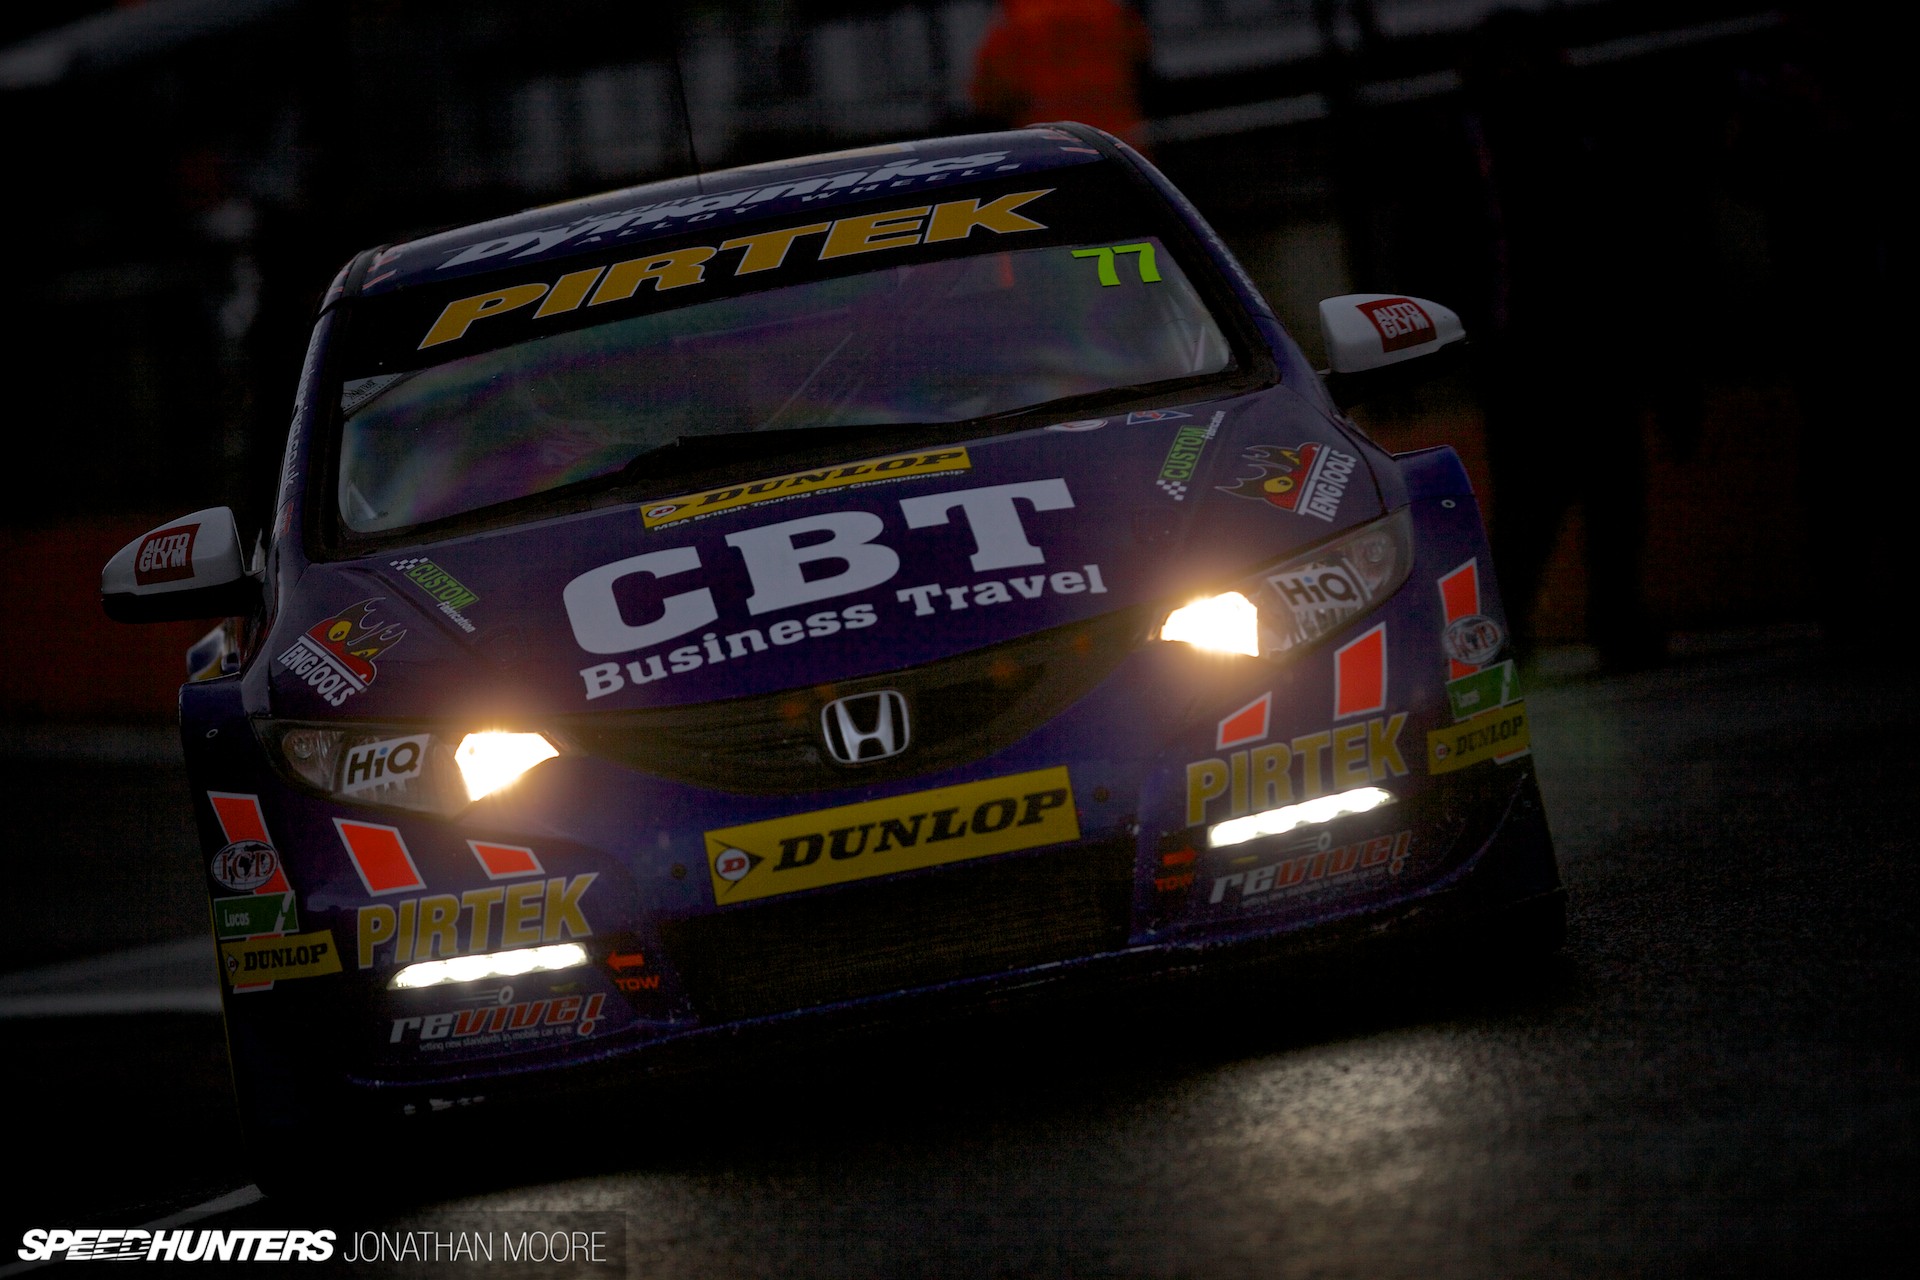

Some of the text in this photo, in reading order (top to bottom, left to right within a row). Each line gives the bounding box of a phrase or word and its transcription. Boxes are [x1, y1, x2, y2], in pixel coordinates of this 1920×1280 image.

[573, 162, 1022, 247] ALLOY WHEELS
[417, 187, 1057, 350] PIRTEK
[1070, 242, 1161, 287] 77
[1372, 302, 1421, 323] AUTO
[1380, 314, 1430, 340] GLYM
[697, 451, 965, 505] DUNLOP
[1163, 428, 1208, 479] CUSTOM
[653, 469, 965, 531] MSA British Touring Car Championship
[138, 546, 188, 572] GLYM
[145, 533, 190, 555] AUTO
[562, 478, 1076, 655] CBT
[409, 562, 477, 609] CUSTOM
[1276, 573, 1358, 606] HiQ
[579, 563, 1108, 700] Business Travel
[1456, 716, 1523, 755] DUNLOP
[347, 742, 420, 785] HiQ
[1185, 712, 1409, 827] PIRTEK
[772, 788, 1067, 872] DUNLOP
[1209, 831, 1412, 904] revive!
[224, 909, 250, 928] Lucas
[357, 872, 599, 970] PIRTEK
[243, 943, 328, 971] DUNLOP
[615, 975, 661, 992] TOW
[390, 993, 607, 1044] revive!
